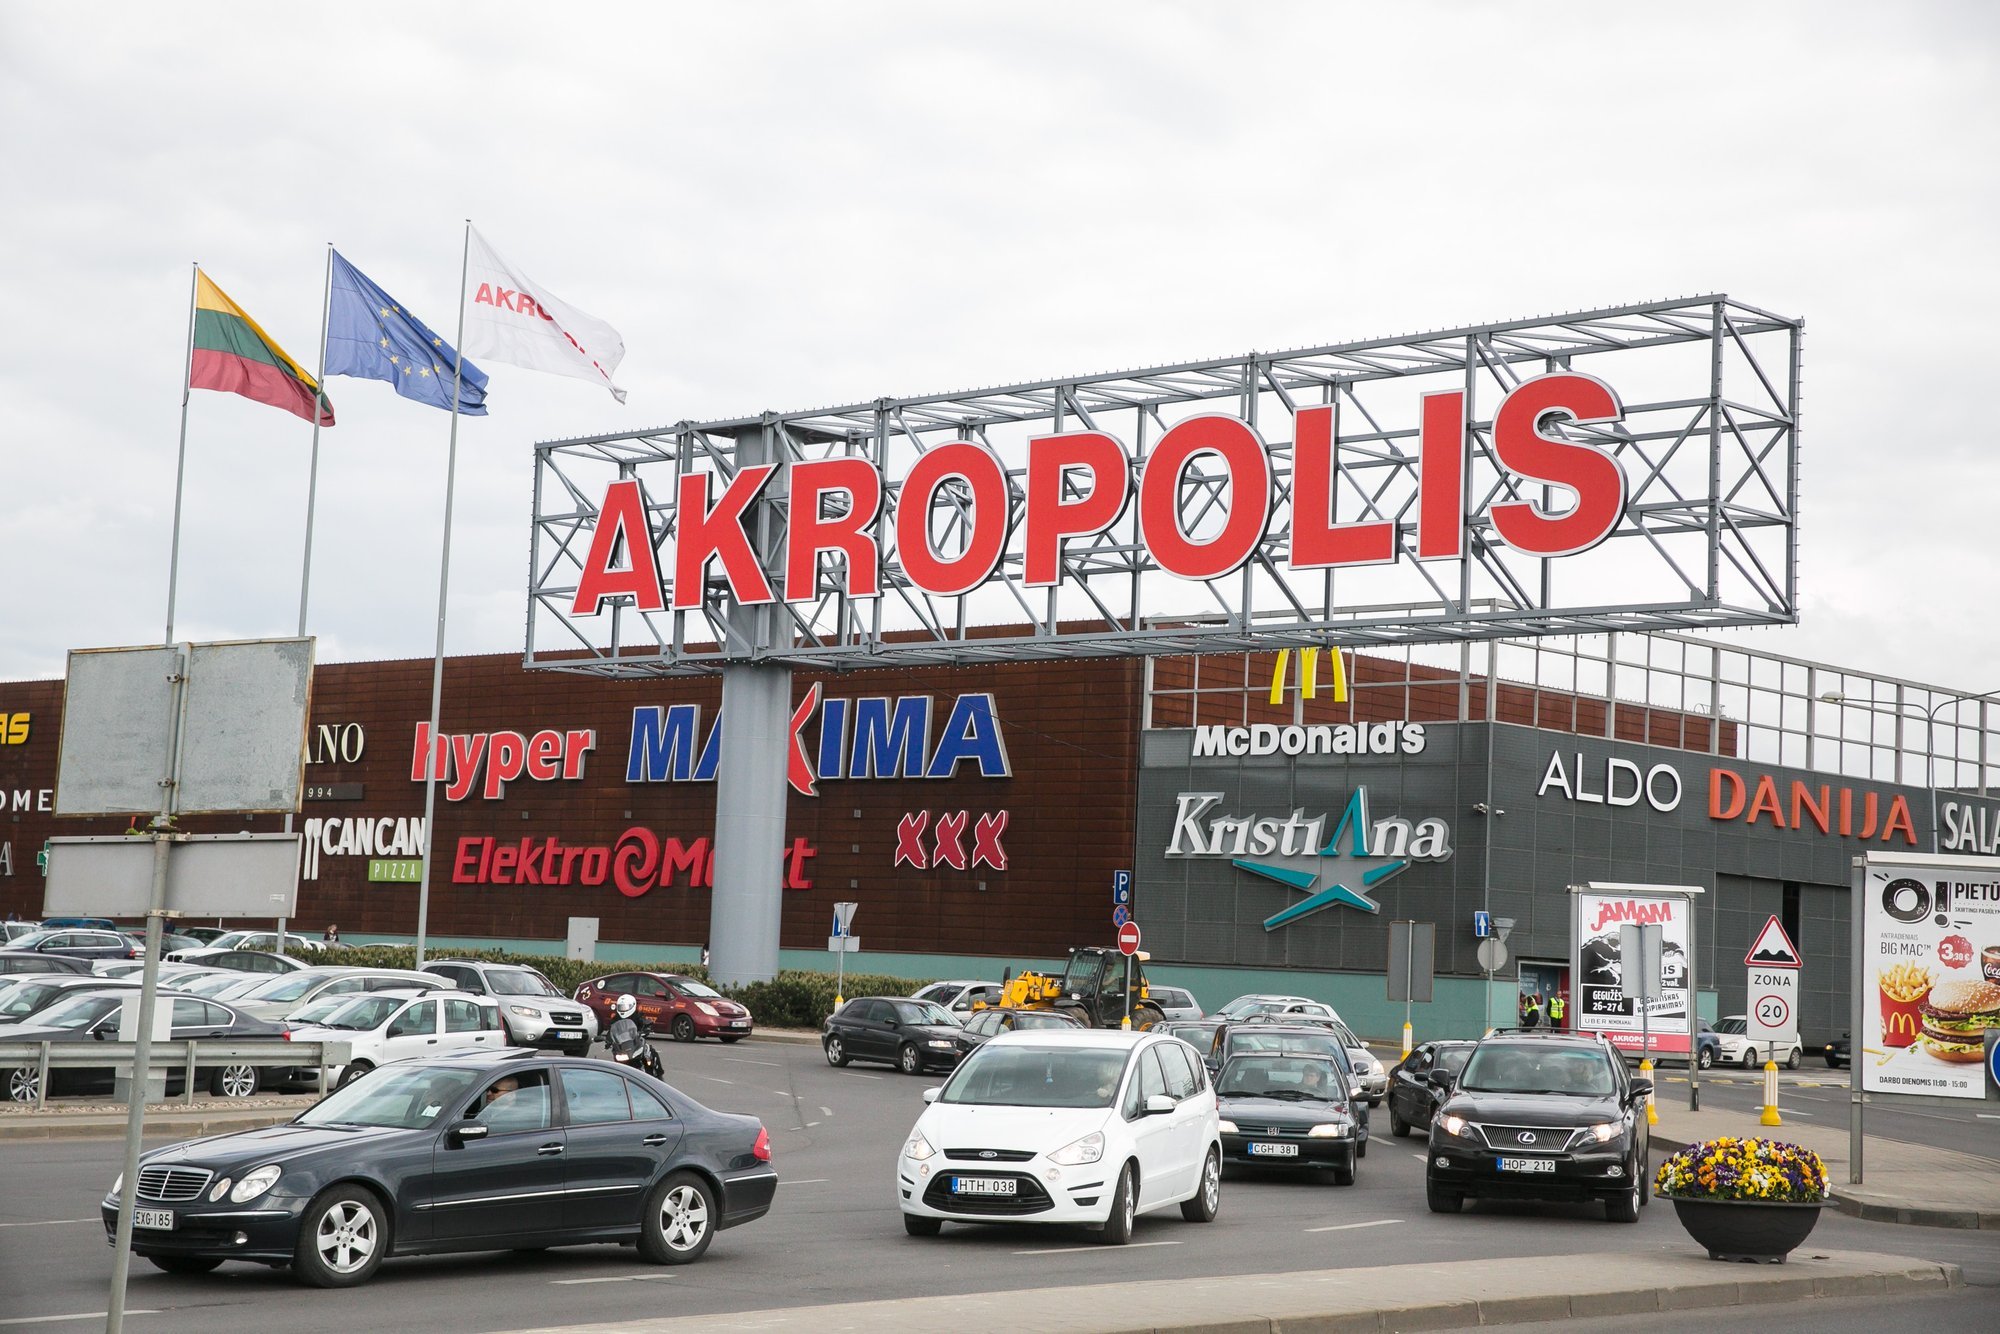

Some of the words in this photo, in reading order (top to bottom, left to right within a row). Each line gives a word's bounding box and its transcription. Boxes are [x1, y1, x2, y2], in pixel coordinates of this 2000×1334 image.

[569, 371, 1630, 618] AKROPOLIS
[1192, 720, 1426, 757] McDonald's
[411, 721, 596, 801] hyper
[1537, 749, 1682, 813] ALDO
[1708, 767, 1918, 846] DANIJA
[321, 817, 426, 856] CANCAN
[452, 836, 611, 885] Elektro
[374, 863, 416, 879] PIZZA
[1880, 941, 1897, 955] BIG
[1661, 965, 1676, 975] IS
[1754, 974, 1791, 986] ZONA
[1636, 1000, 1684, 1014] ASIPIRKIMAS!
[1762, 1004, 1782, 1018] 20
[1612, 1034, 1658, 1044] AKROPOIS
[1879, 1076, 1901, 1085] DARBO
[1901, 1077, 1932, 1087] DIENOMIS
[1254, 1144, 1274, 1153] CGH
[1280, 1145, 1296, 1154] 381
[1503, 1159, 1527, 1170] HOP
[1533, 1160, 1554, 1171] 212
[959, 1179, 985, 1191] HTH
[992, 1180, 1015, 1192] 038
